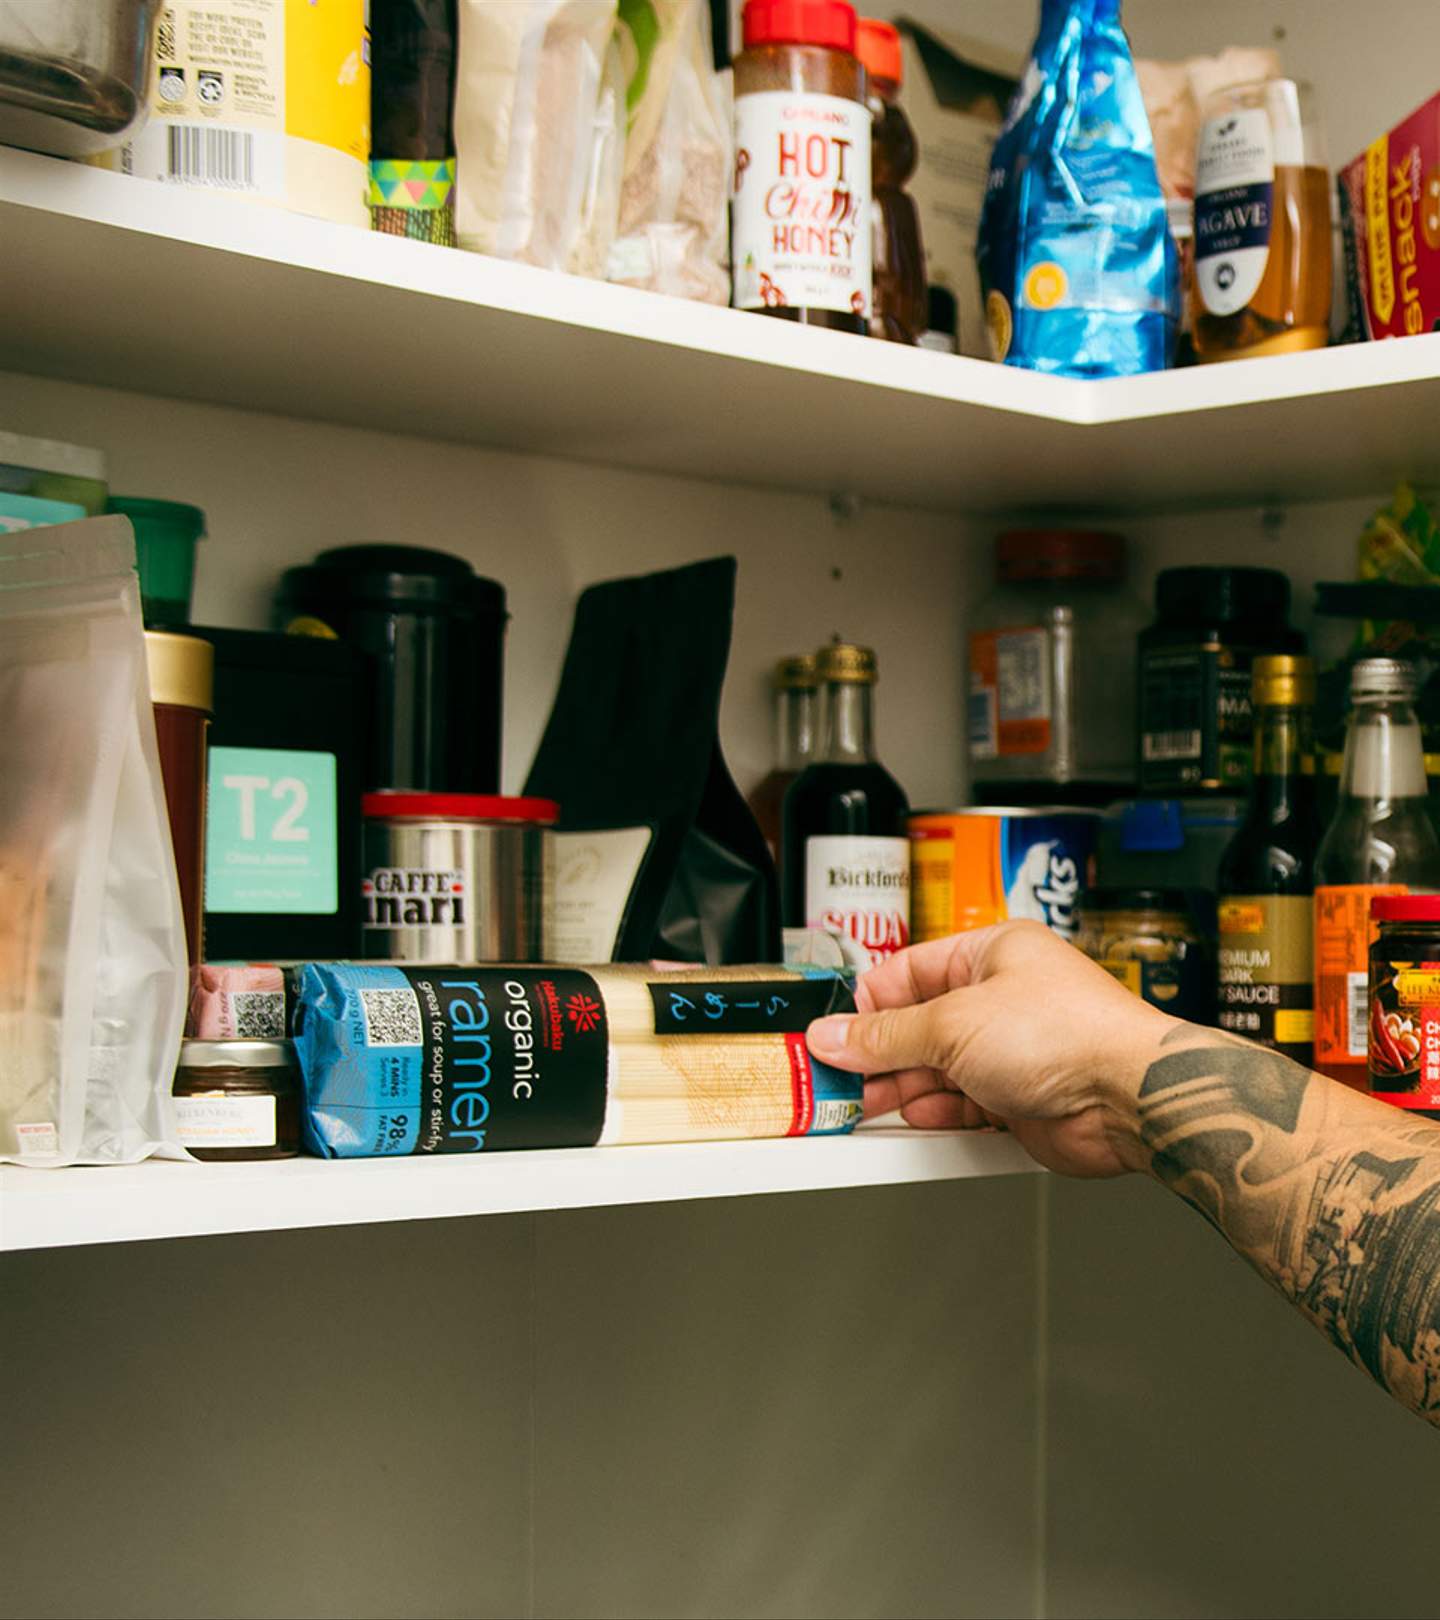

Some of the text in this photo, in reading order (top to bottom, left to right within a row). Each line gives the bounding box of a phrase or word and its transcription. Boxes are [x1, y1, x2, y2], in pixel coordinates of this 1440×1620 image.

[778, 131, 853, 182] HOT
[1198, 202, 1268, 235] AGAVE
[773, 223, 854, 259] HONEY
[1390, 154, 1424, 337] snack
[223, 774, 311, 842] T2
[1226, 984, 1280, 1004] SAUCE
[353, 1020, 365, 1047] NET
[504, 980, 540, 1099] organic
[390, 1067, 400, 1098] MINS
[417, 980, 447, 1152] great for soup or stir-fry
[377, 1115, 386, 1132] FAT
